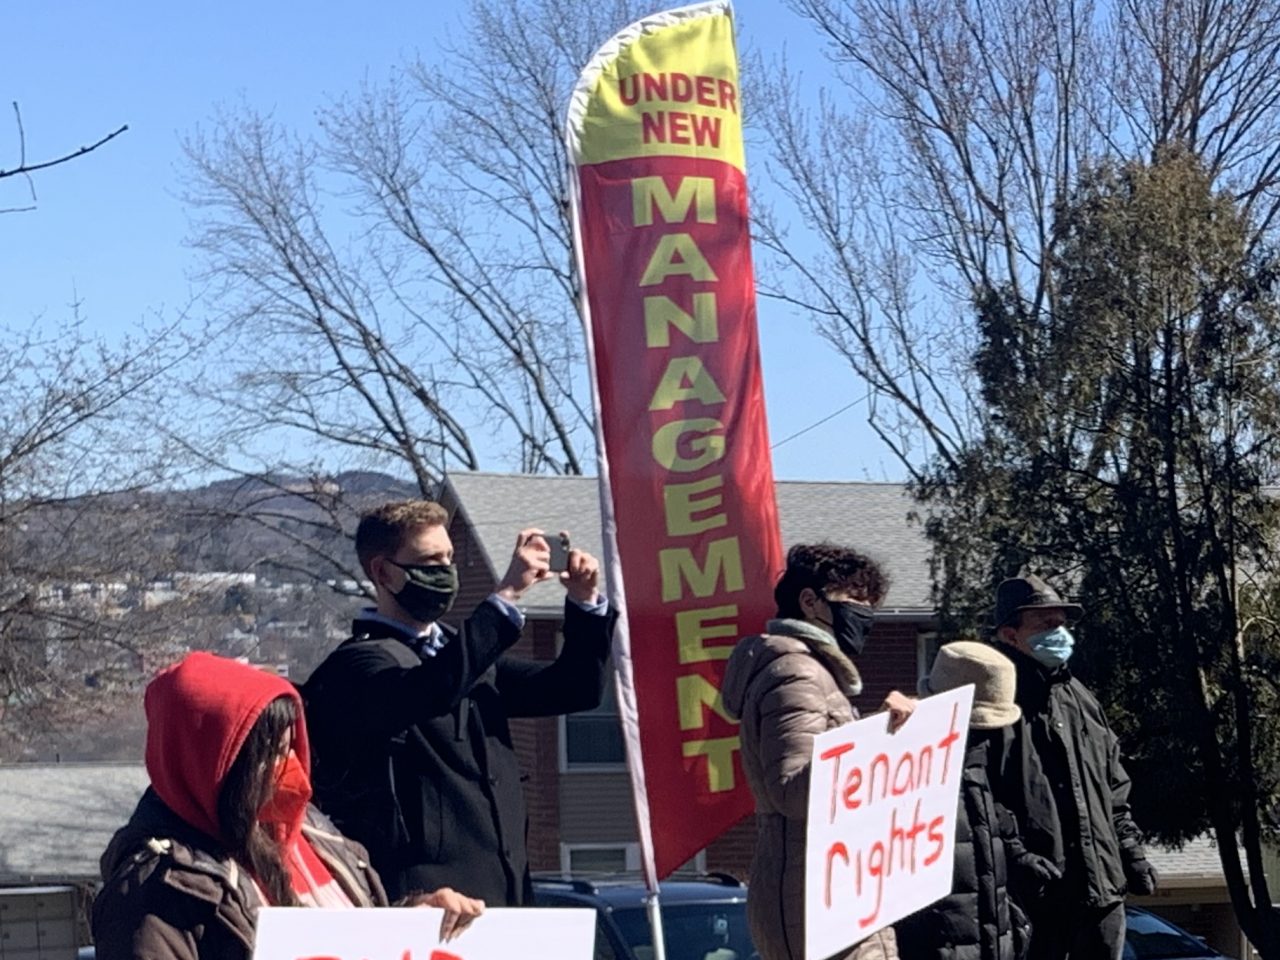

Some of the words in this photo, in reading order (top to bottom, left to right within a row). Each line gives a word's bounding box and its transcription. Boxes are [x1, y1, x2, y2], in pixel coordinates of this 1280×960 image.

[619, 73, 737, 114] UNDER
[642, 111, 721, 148] NEW
[631, 175, 745, 792] MANAGEMENT
[820, 702, 959, 824] Tenant
[824, 798, 944, 928] rights
